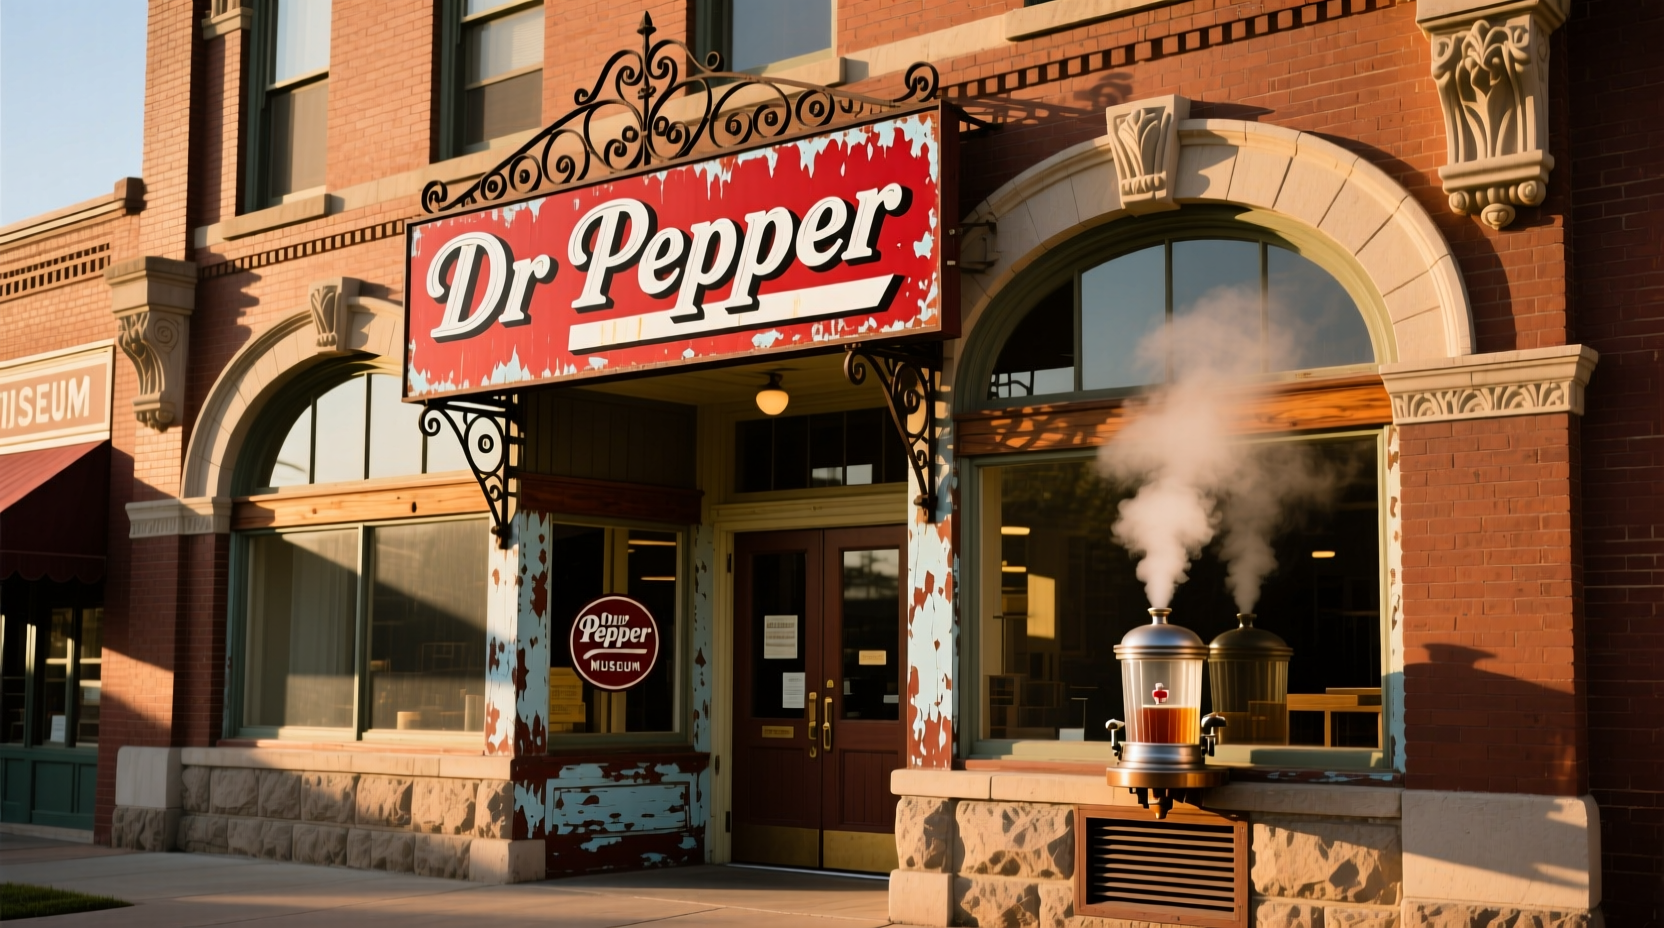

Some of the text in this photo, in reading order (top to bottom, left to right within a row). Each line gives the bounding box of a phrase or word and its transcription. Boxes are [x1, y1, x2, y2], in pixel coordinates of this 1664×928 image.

[426, 182, 911, 341] Dr Pepper
[0, 375, 90, 429] USEUM
[579, 614, 652, 648] Pepper
